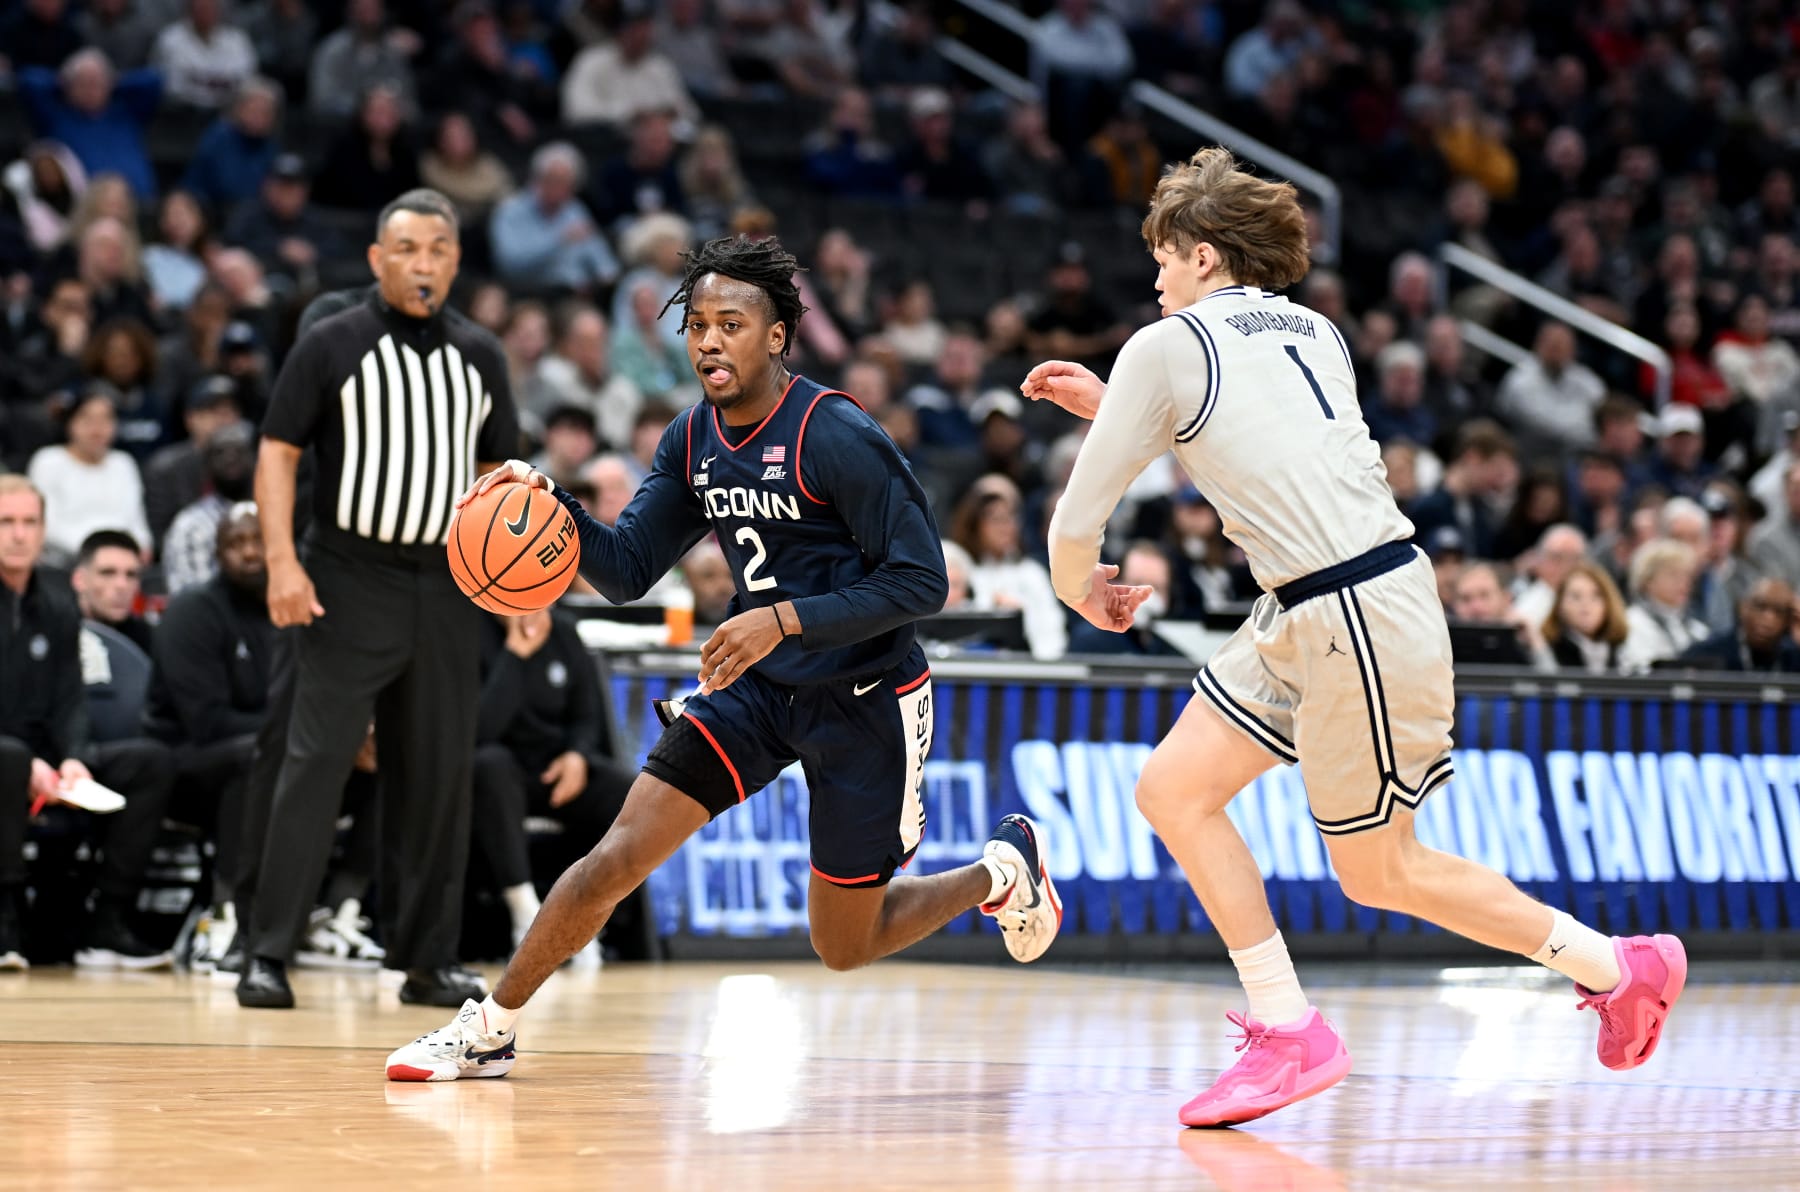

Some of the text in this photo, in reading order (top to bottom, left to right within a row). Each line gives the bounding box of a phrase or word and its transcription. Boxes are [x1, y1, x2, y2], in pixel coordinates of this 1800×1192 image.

[1225, 310, 1316, 339] BRUMBAUGH
[1283, 345, 1336, 420] 1
[735, 526, 777, 592] 2
